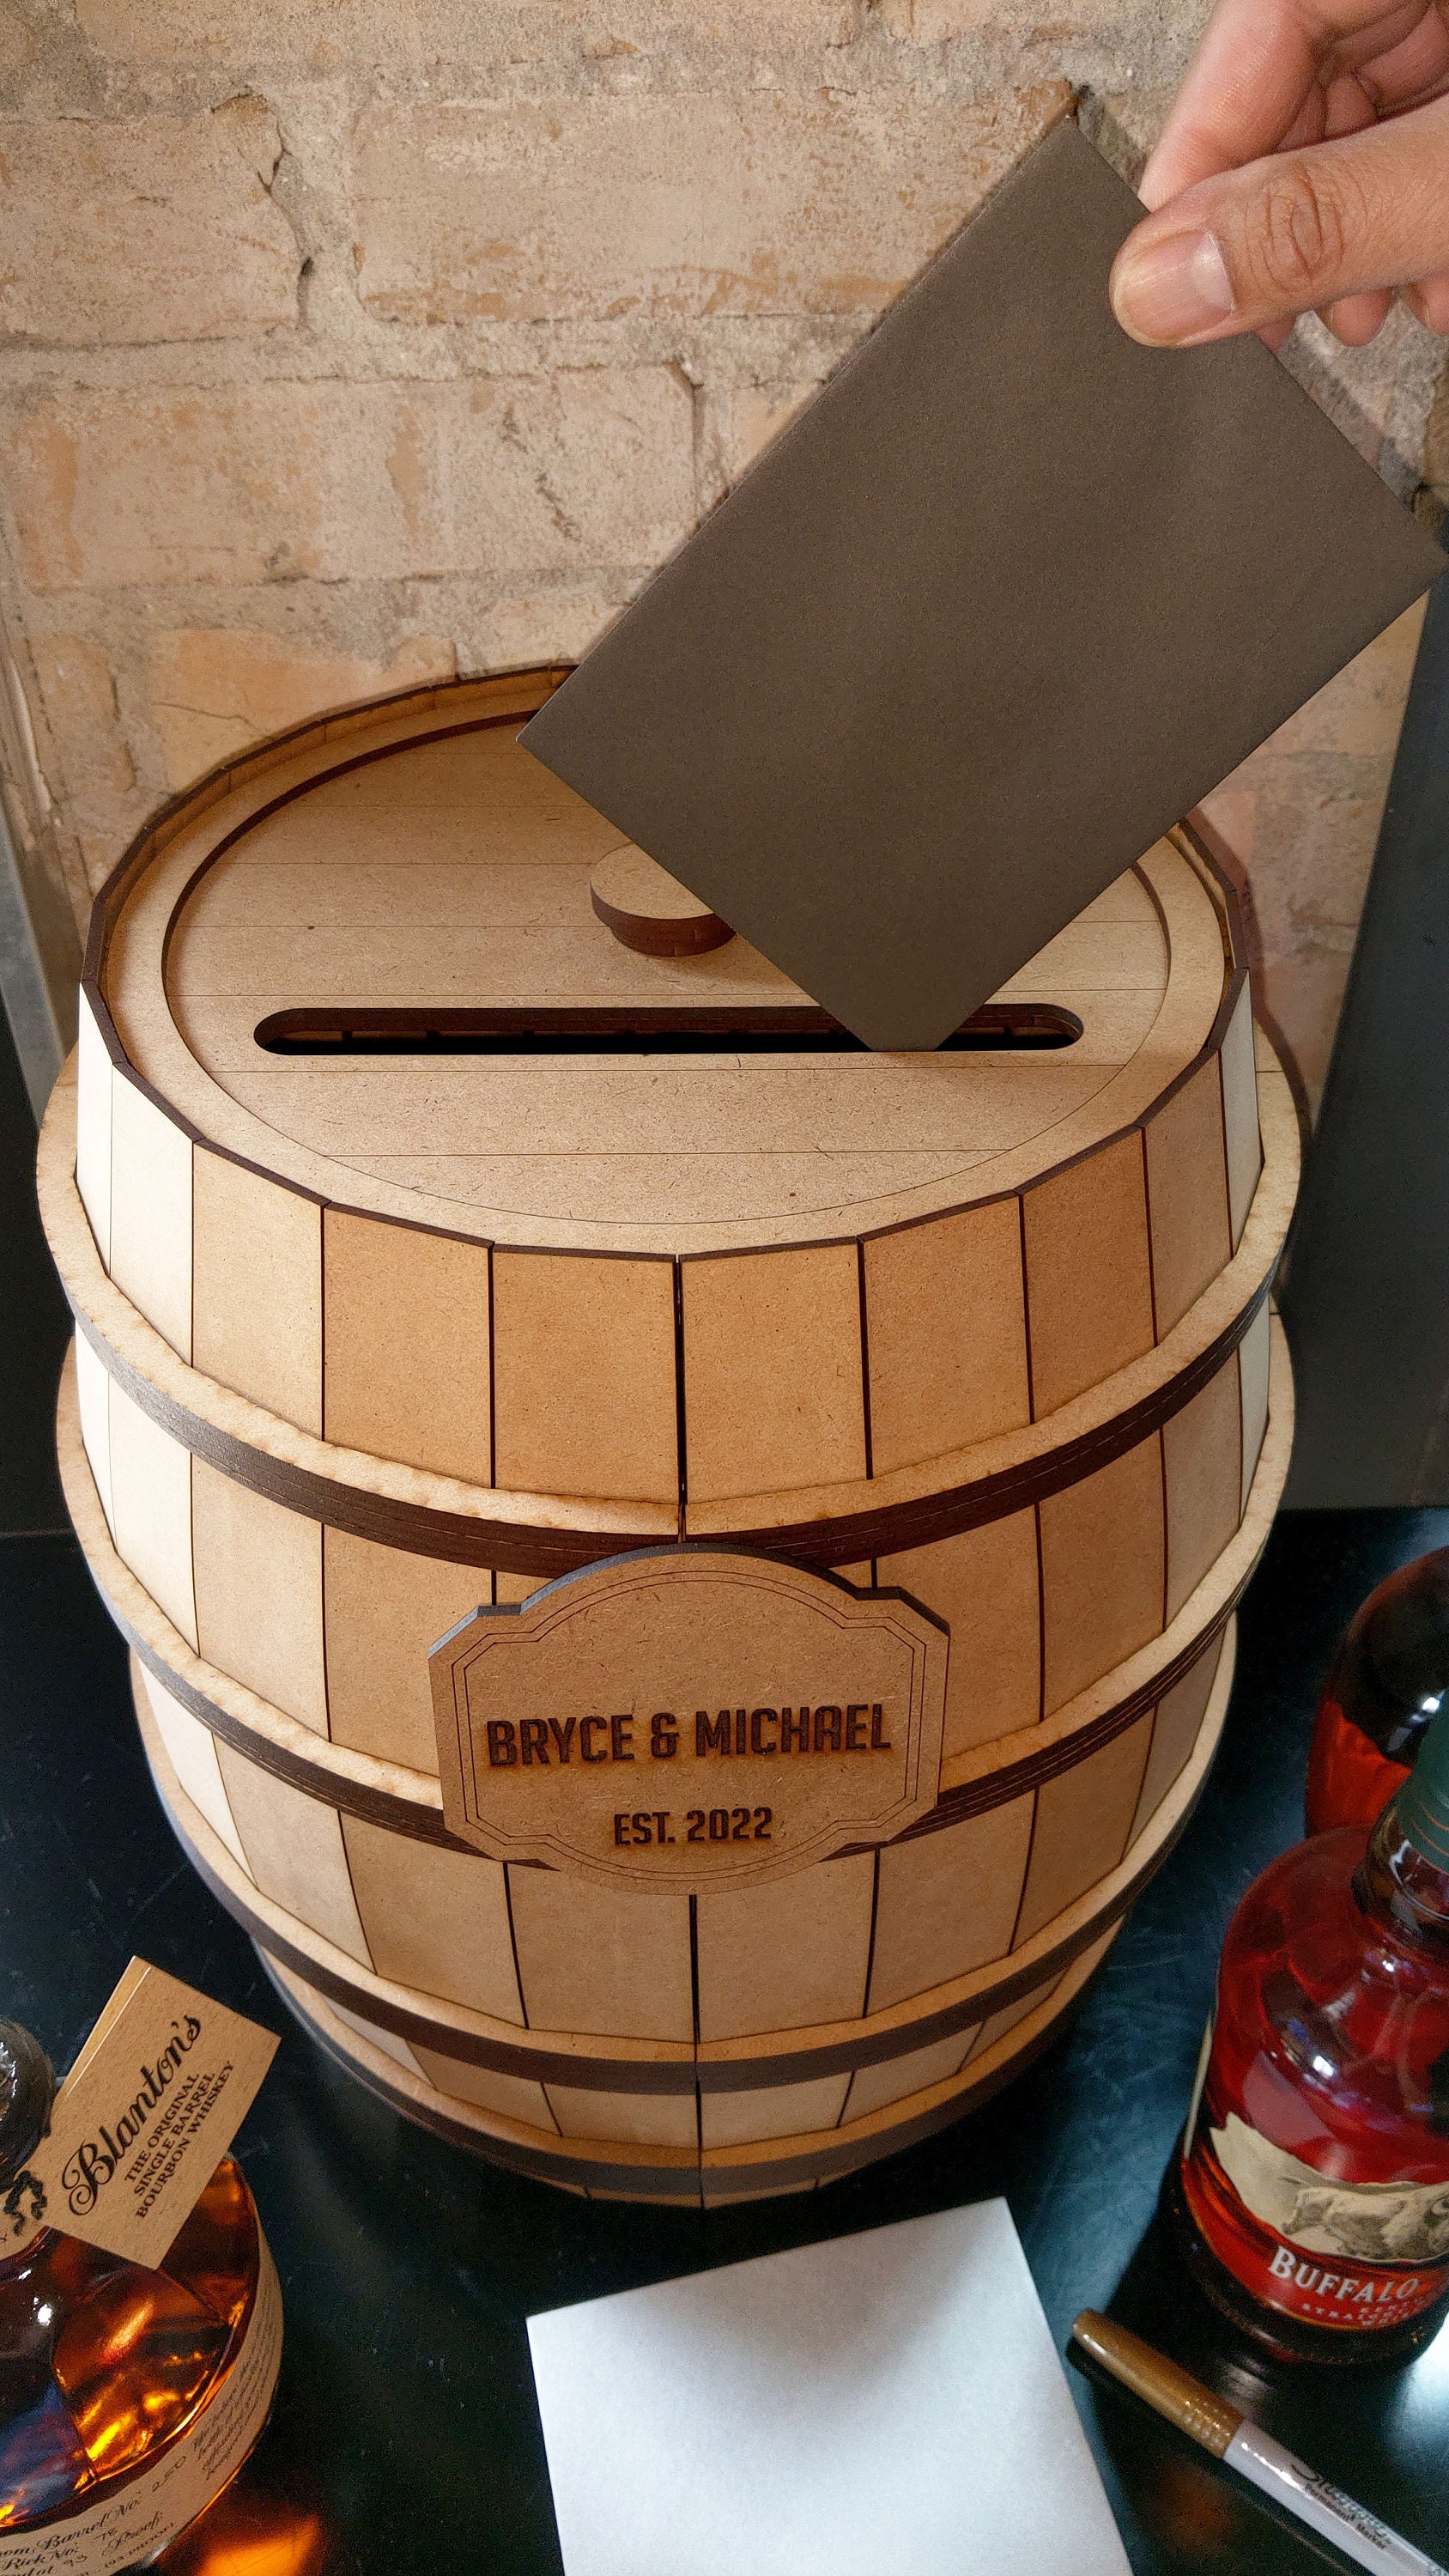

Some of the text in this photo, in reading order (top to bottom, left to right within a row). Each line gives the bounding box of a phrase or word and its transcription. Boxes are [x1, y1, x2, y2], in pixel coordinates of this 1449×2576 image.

[487, 1703, 891, 1767] BRYCE & MICHAEL
[614, 1806, 772, 1846] EST. 2022
[61, 2015, 202, 2215] Blanton's
[124, 2072, 199, 2182] THE ORIGINAL
[134, 2072, 215, 2196] SINGLE BARREL
[136, 2060, 233, 2218] BOURBON WHISKEY
[1267, 2245, 1421, 2303] BUFFALO
